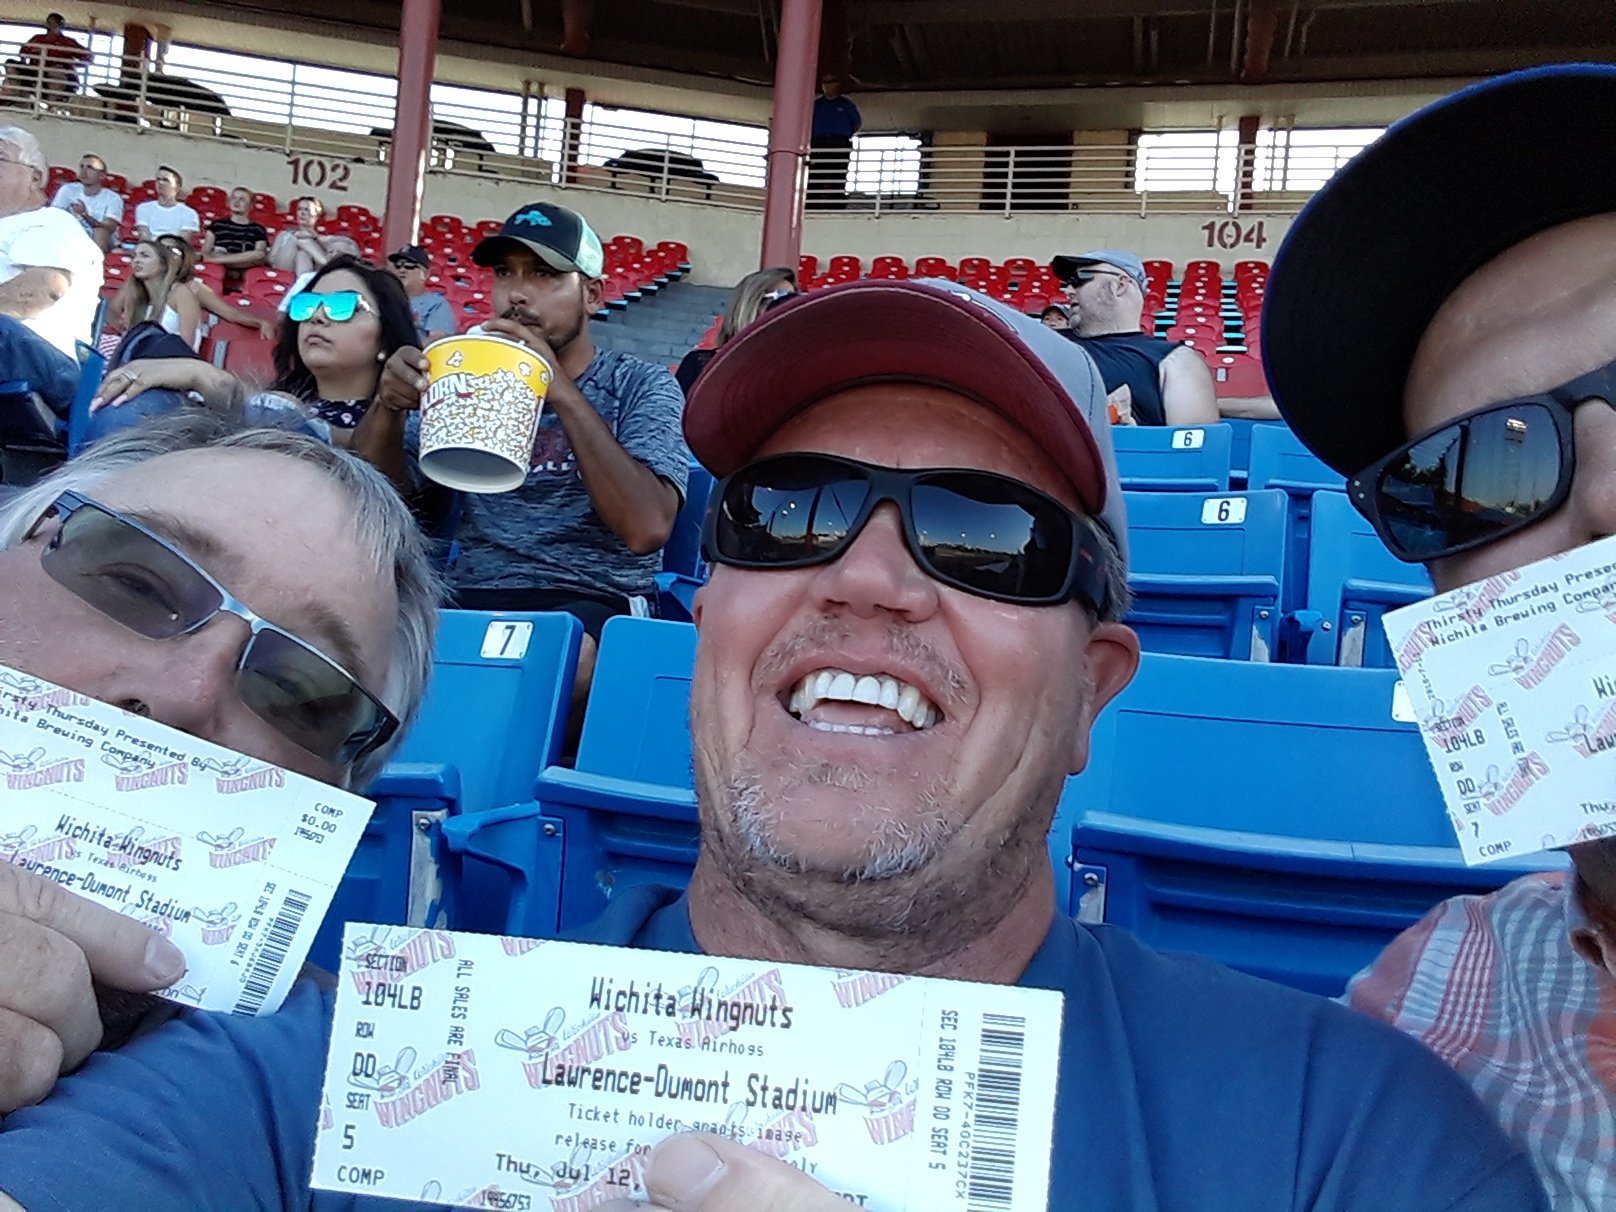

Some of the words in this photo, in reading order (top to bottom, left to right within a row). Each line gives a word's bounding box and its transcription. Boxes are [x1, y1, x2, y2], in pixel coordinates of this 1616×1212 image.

[286, 157, 350, 192] 102
[1201, 220, 1267, 250] 104
[1183, 431, 1193, 447] 6
[1217, 500, 1230, 522] 6
[1425, 606, 1482, 632] Thirsty
[1489, 580, 1560, 611] Thursday
[1430, 622, 1488, 647] Wichita
[1495, 601, 1557, 627] Brewing
[499, 624, 517, 656] 7
[36, 718, 93, 747] Brewing
[101, 741, 156, 769] Company
[46, 703, 109, 736] Thursday
[115, 729, 186, 762] Presented
[191, 757, 207, 771] By
[1444, 728, 1485, 753] 104LB
[301, 813, 337, 833] $0.00
[314, 803, 344, 817] COMP
[55, 814, 113, 848] Wichita
[117, 834, 183, 871] Wingnuts
[1471, 821, 1479, 838] 7
[1479, 840, 1512, 857] COMP
[135, 889, 191, 923] Stadium
[456, 958, 474, 979] ALL
[361, 981, 423, 1011] 104LB
[451, 986, 471, 1020] SALES
[589, 976, 676, 1018] Wichita
[690, 985, 793, 1031] Wingnuts
[941, 1009, 958, 1031] SEC
[447, 1024, 465, 1047] ARE
[649, 1030, 692, 1050] Texas
[701, 1036, 763, 1058] Airhogs
[541, 1051, 730, 1105] Lawrence-Dumont
[745, 1073, 838, 1115] Stadium
[934, 1077, 953, 1100] ROW
[346, 1091, 371, 1111] SEAT
[342, 1124, 356, 1150] 5
[568, 1102, 620, 1124] Ticket
[628, 1110, 683, 1133] holder
[757, 1126, 803, 1145] image
[555, 1132, 616, 1154] release
[626, 1138, 651, 1155] for
[930, 1126, 949, 1155] SEAT
[337, 1165, 385, 1187] COMP
[495, 1153, 540, 1179] Thu,
[556, 1160, 590, 1182] Jul
[606, 1167, 641, 1191] 12,
[928, 1161, 946, 1170] 5
